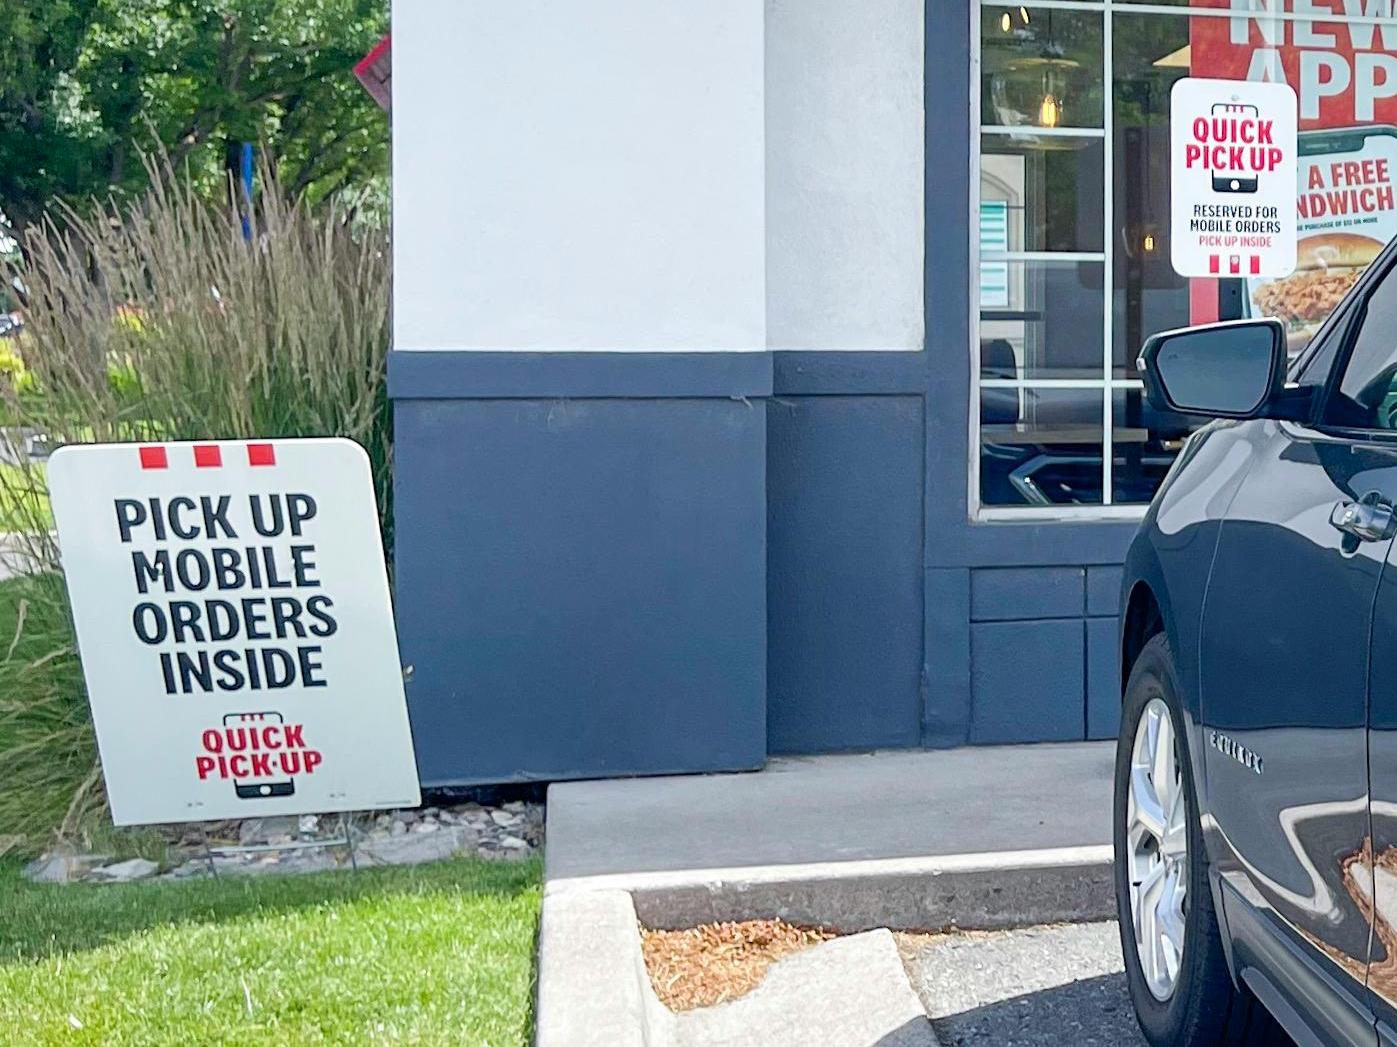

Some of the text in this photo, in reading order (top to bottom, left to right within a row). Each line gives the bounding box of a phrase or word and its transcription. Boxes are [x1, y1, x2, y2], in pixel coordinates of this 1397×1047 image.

[1193, 117, 1273, 144] QUICK
[1186, 144, 1283, 172] PICK UP
[1308, 158, 1390, 190] A FREE
[1193, 204, 1278, 219] RESERVED FOR
[1297, 186, 1395, 219] NDWICH
[1190, 218, 1232, 232] MOBILE
[1235, 220, 1281, 233] ORDERS
[1199, 234, 1272, 248] PICK UP INSIDE
[114, 493, 318, 543] PICK UP
[131, 545, 321, 594] MOBILE
[133, 595, 338, 645] ORDERS
[159, 645, 328, 695] INSIDE
[202, 724, 306, 753] QUICK
